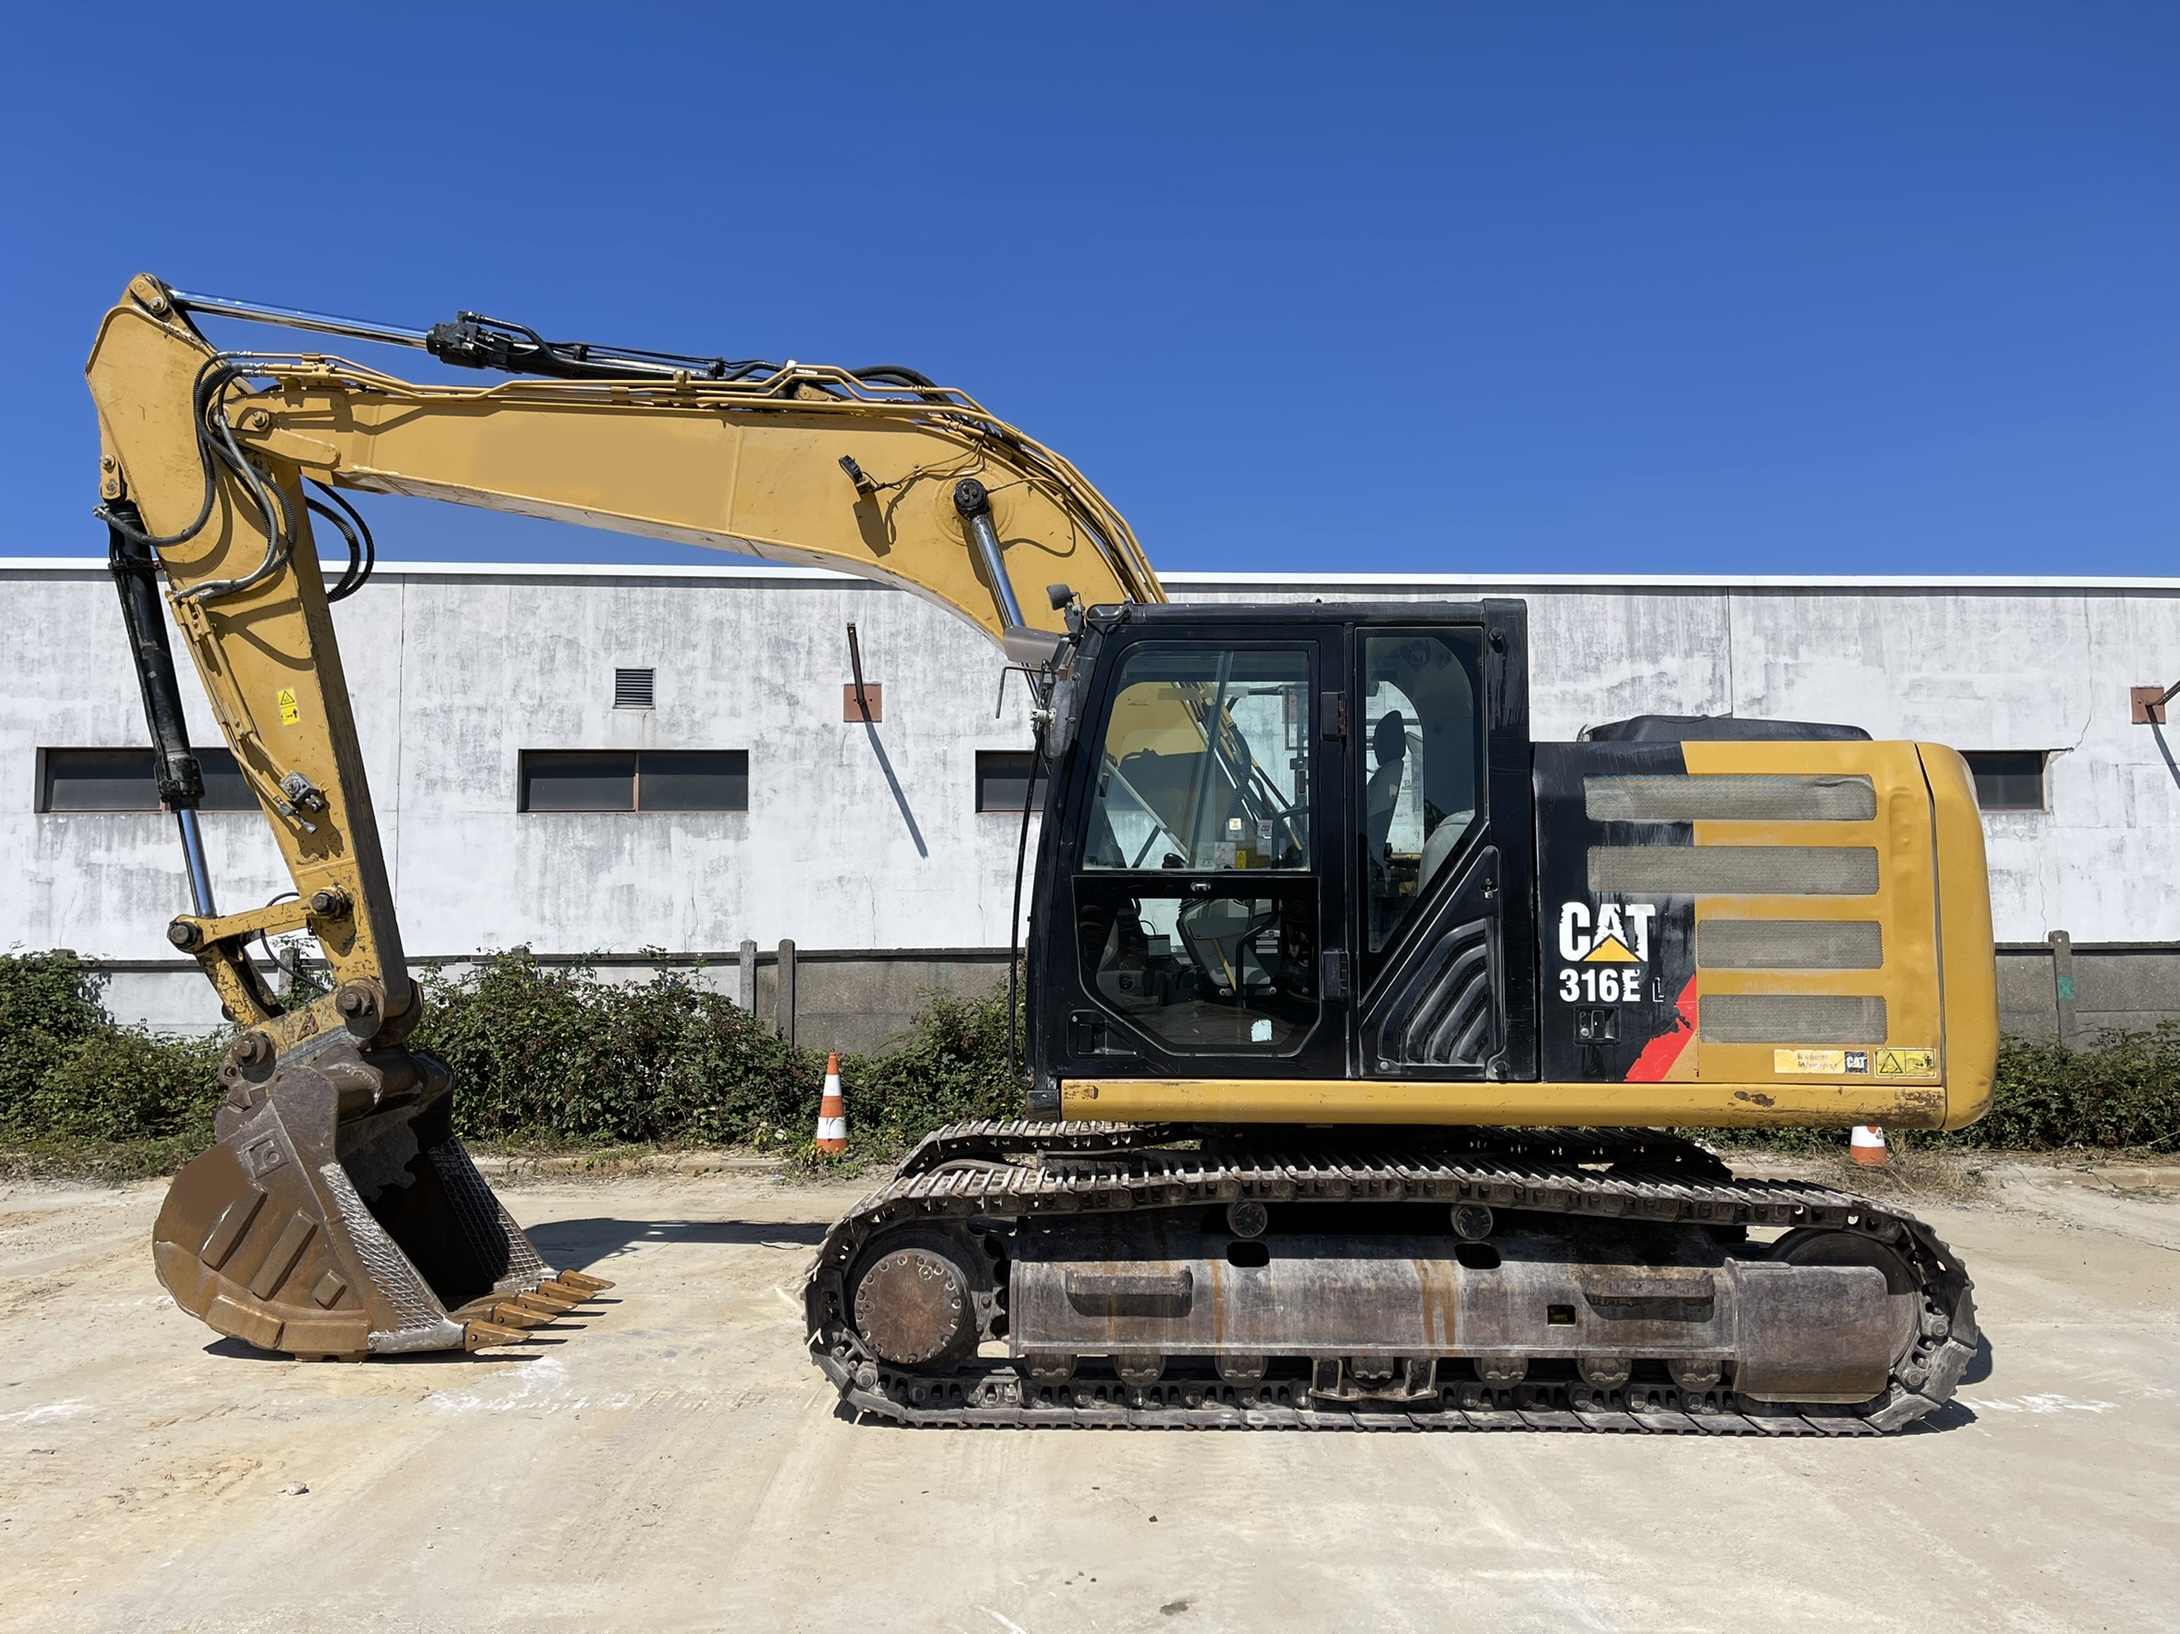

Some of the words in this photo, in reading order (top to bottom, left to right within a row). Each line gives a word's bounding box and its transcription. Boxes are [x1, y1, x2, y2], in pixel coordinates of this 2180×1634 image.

[1559, 902, 1656, 962] CAT
[1559, 969, 1641, 1003] 316E
[1846, 1056, 1868, 1069] CAT
